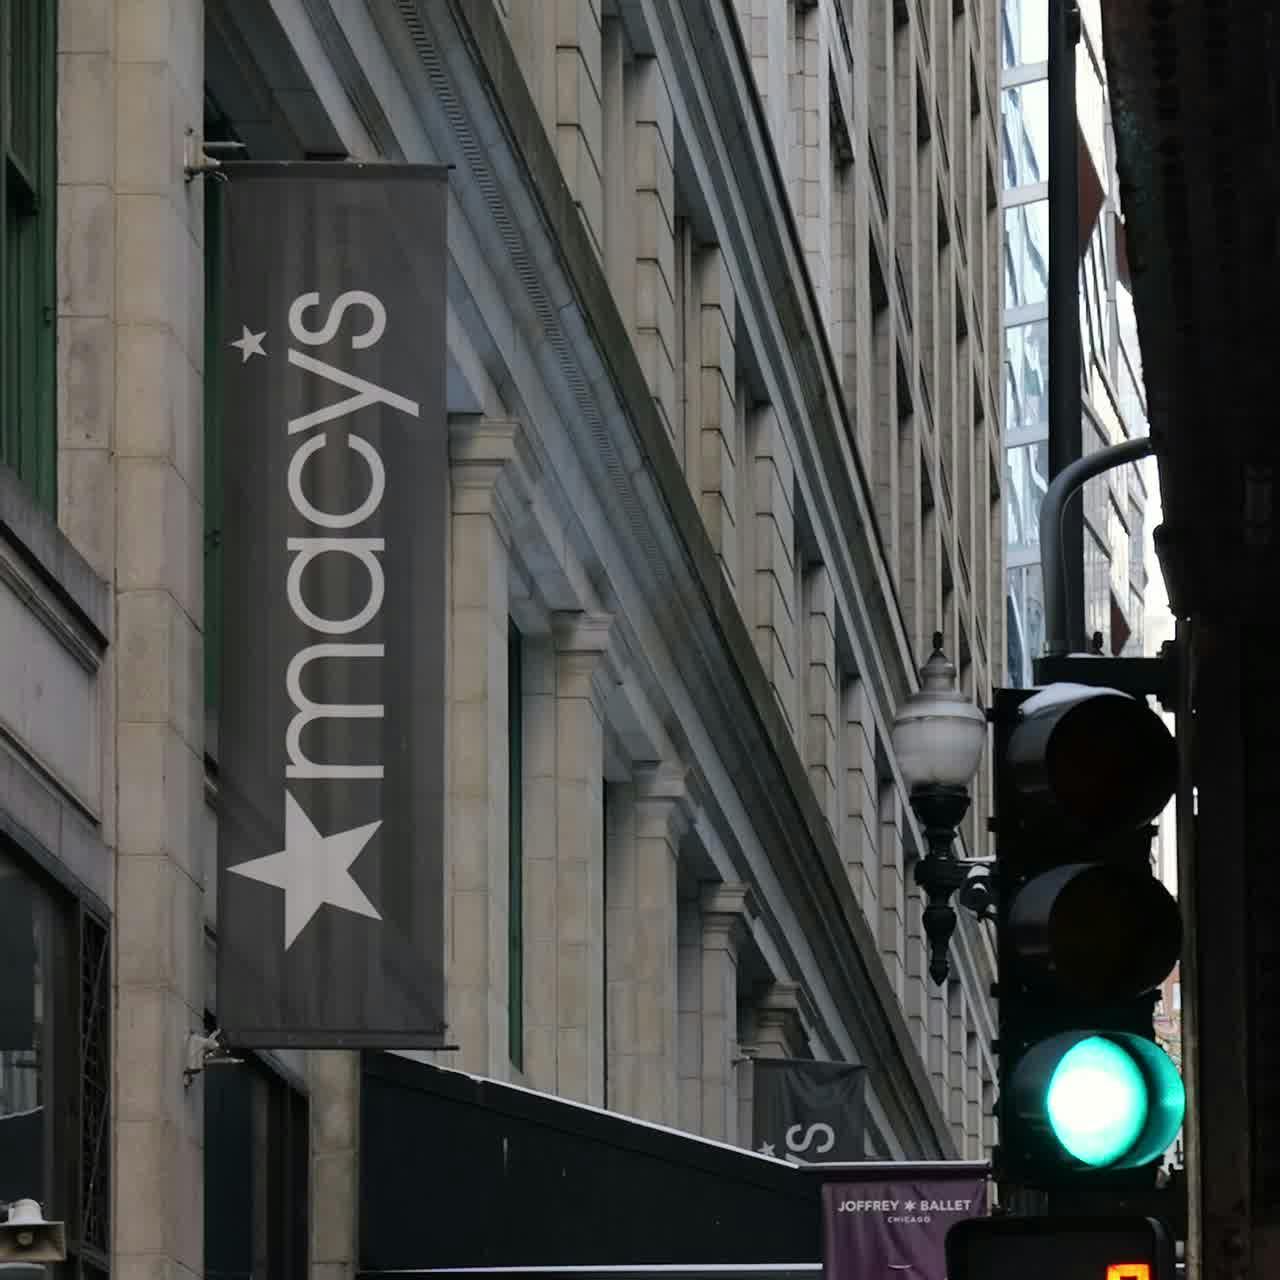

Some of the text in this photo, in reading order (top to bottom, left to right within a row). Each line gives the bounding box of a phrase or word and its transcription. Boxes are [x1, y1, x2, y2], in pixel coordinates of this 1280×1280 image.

[837, 1199, 972, 1212] JOFFREY BALLET
[887, 1216, 932, 1224] CHICAGO
